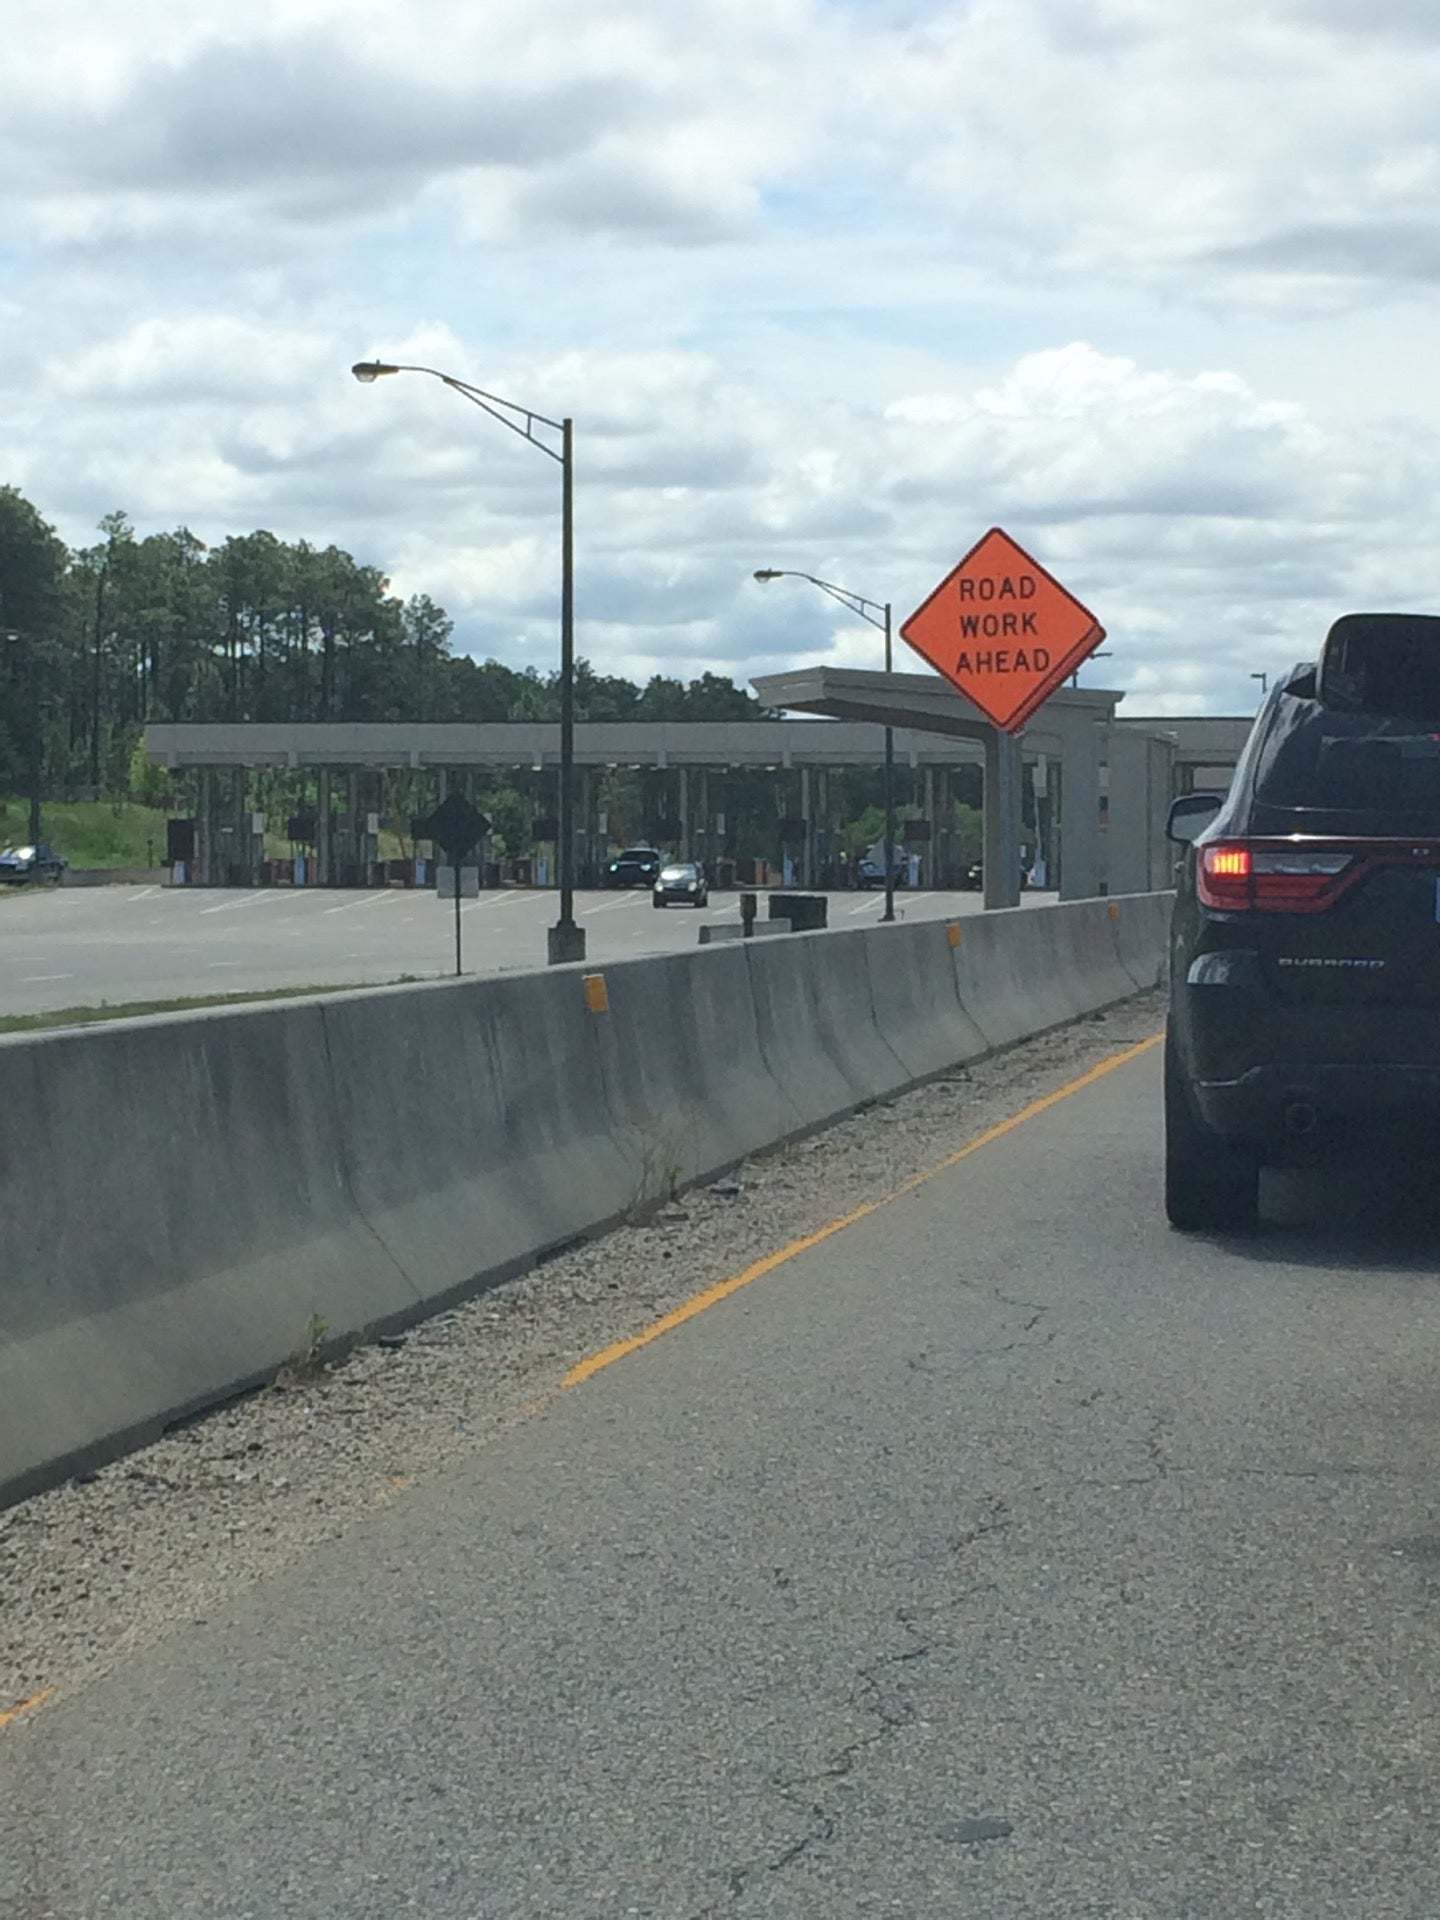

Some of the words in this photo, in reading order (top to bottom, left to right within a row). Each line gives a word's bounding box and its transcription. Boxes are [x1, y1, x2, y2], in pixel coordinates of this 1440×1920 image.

[960, 576, 1036, 602] ROAD
[960, 612, 1038, 638] WORK
[956, 649, 1049, 675] AHEAD
